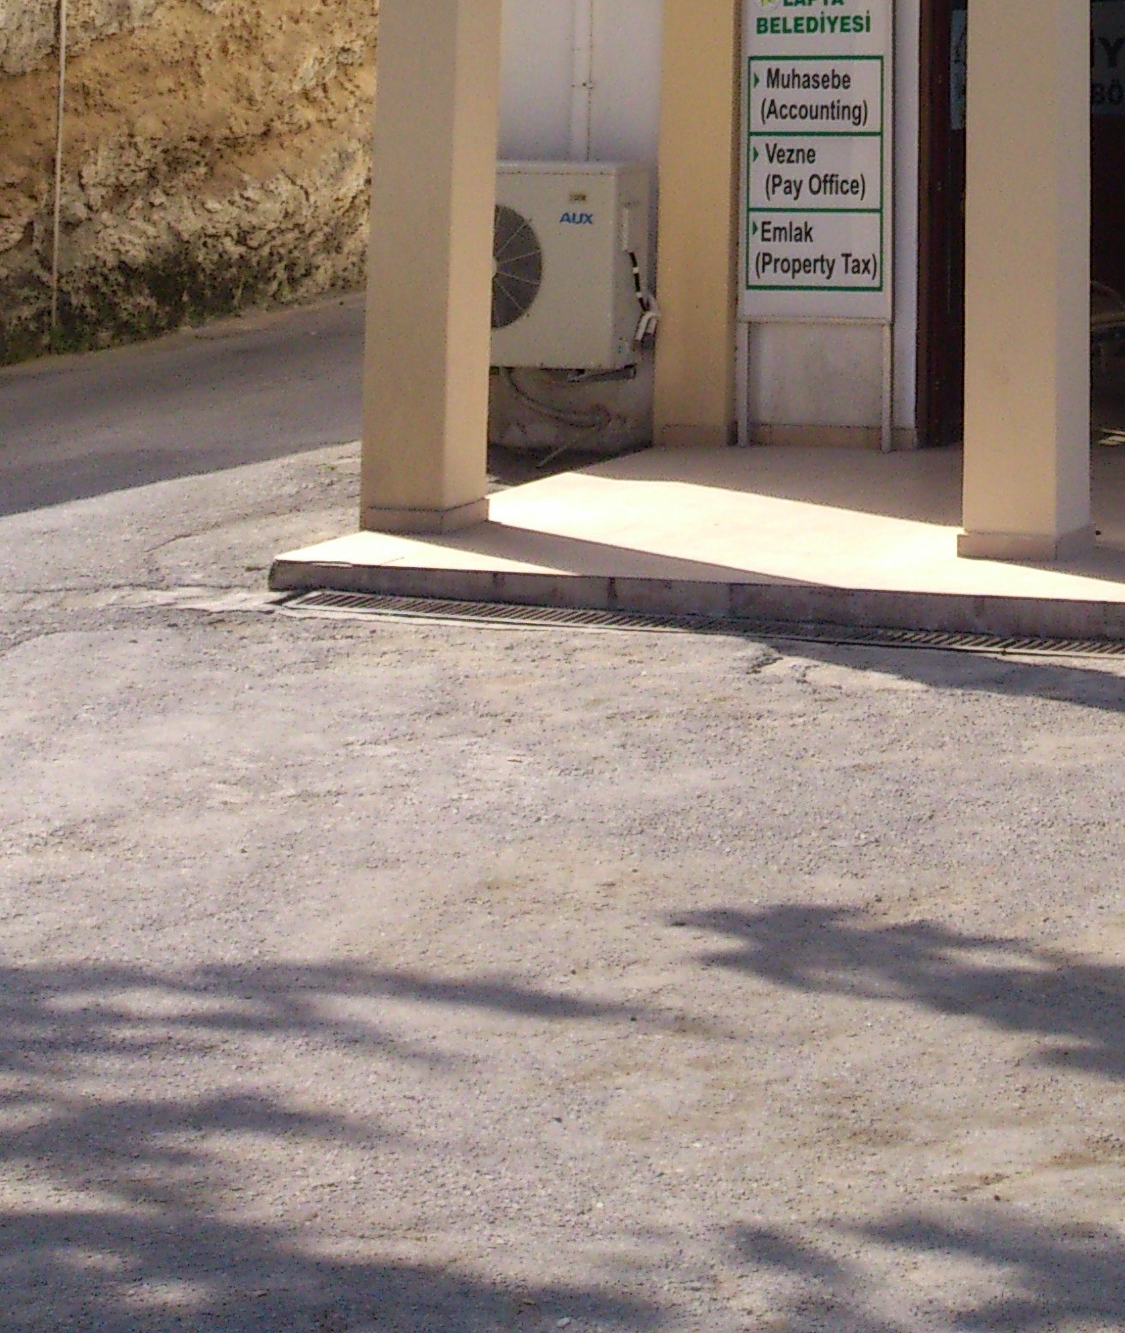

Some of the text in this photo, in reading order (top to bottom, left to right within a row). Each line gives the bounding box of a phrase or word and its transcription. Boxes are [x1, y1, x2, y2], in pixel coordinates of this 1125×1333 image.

[755, 10, 871, 35] BELEDİYESİ
[766, 67, 851, 90] Muhasebe
[761, 99, 868, 126] (Accounting)
[765, 143, 816, 164] Vezne
[765, 174, 866, 201] (Pay Office)
[559, 212, 593, 225] AUX
[761, 221, 814, 243] Emlak
[755, 252, 878, 280] (Property Tax)
